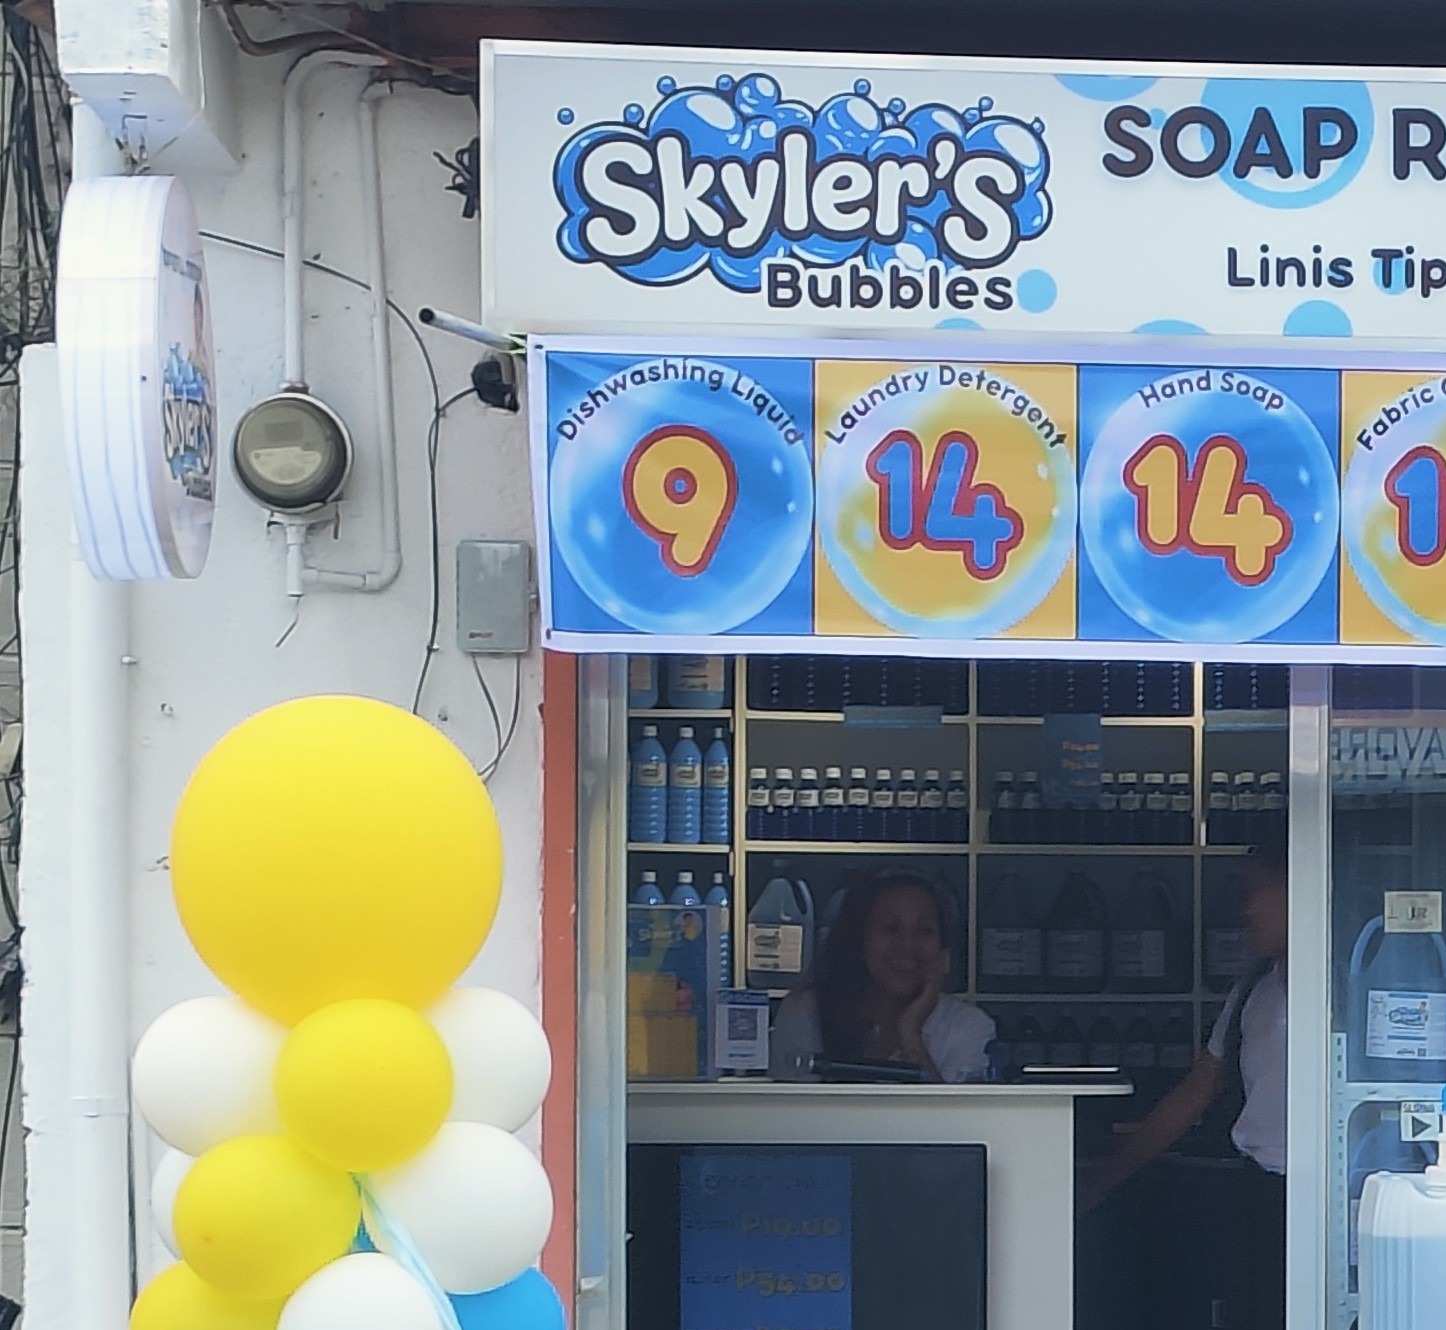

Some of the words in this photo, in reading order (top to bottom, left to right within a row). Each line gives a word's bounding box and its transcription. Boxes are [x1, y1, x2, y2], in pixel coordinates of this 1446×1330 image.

[1103, 105, 1358, 180] SOAP
[766, 262, 1014, 311] Bubbles
[1226, 244, 1355, 288] Linis
[557, 359, 724, 443] Dishwashing
[731, 375, 805, 446] Liquid
[824, 366, 929, 446] Laundry
[938, 364, 1068, 450] Detergent
[1138, 371, 1212, 409] Hand
[1219, 372, 1286, 413] Soap
[1356, 385, 1435, 452] Fabric
[623, 425, 739, 578] 9
[866, 430, 1024, 580] 14
[1122, 434, 1293, 586] 14
